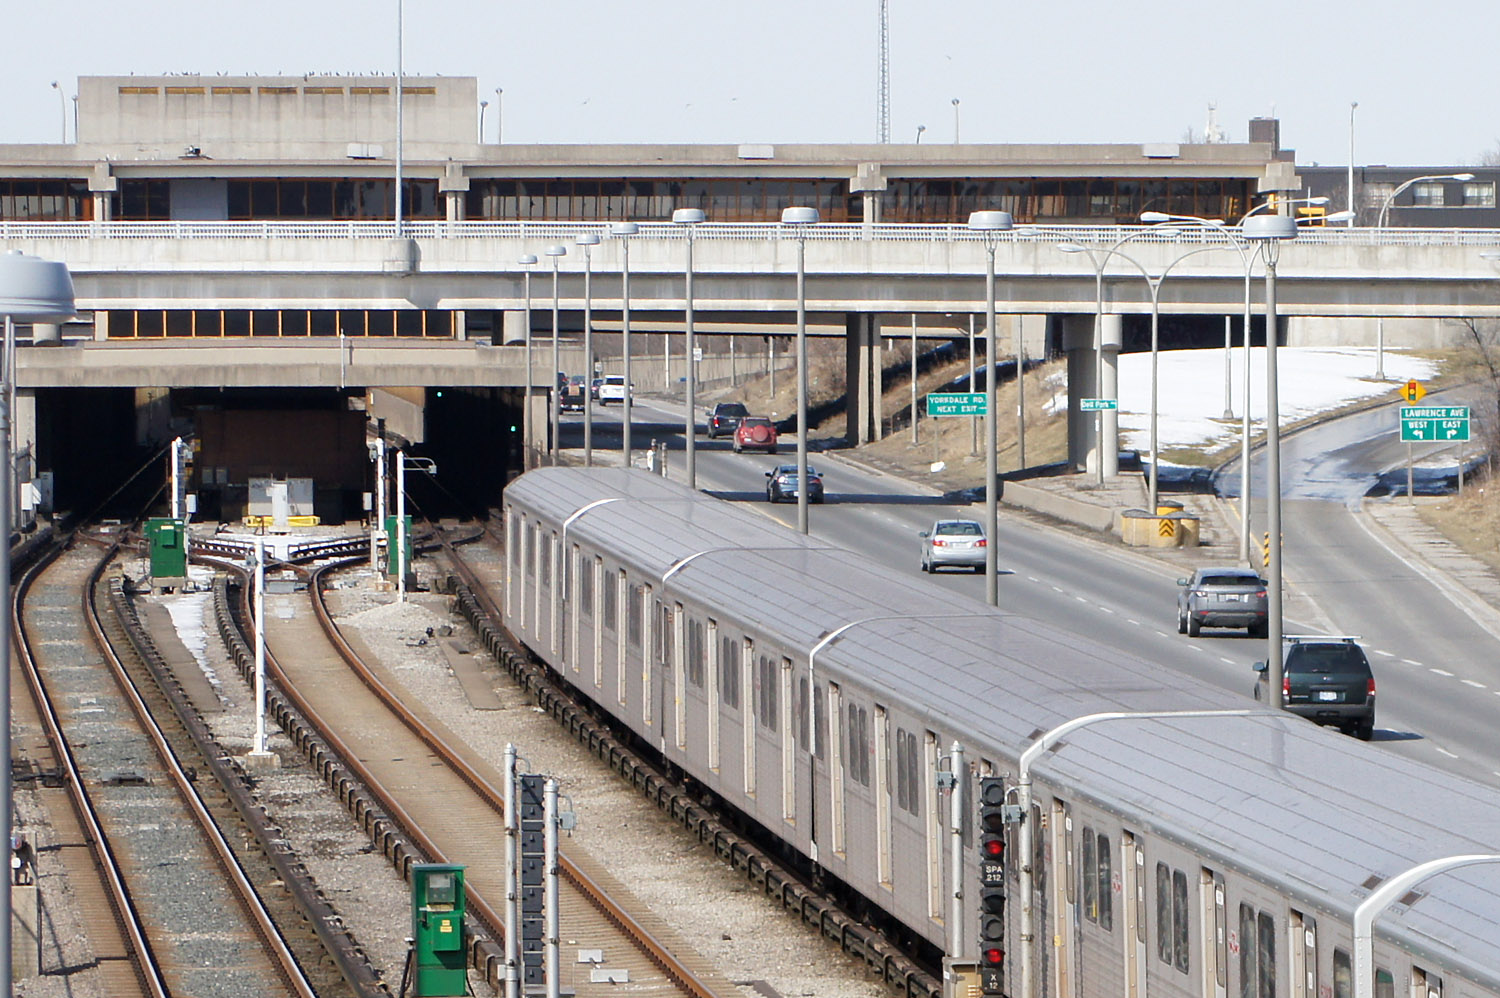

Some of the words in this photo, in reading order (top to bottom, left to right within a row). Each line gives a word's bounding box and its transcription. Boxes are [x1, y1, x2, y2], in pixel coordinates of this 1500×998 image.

[937, 405, 957, 413] NEXT
[961, 405, 977, 413] EXIT
[1405, 409, 1446, 417] LAWRENCE
[1450, 409, 1464, 417] AVE
[1408, 421, 1427, 429] WEST
[986, 865, 1003, 874] SPA
[986, 874, 1002, 882] 212
